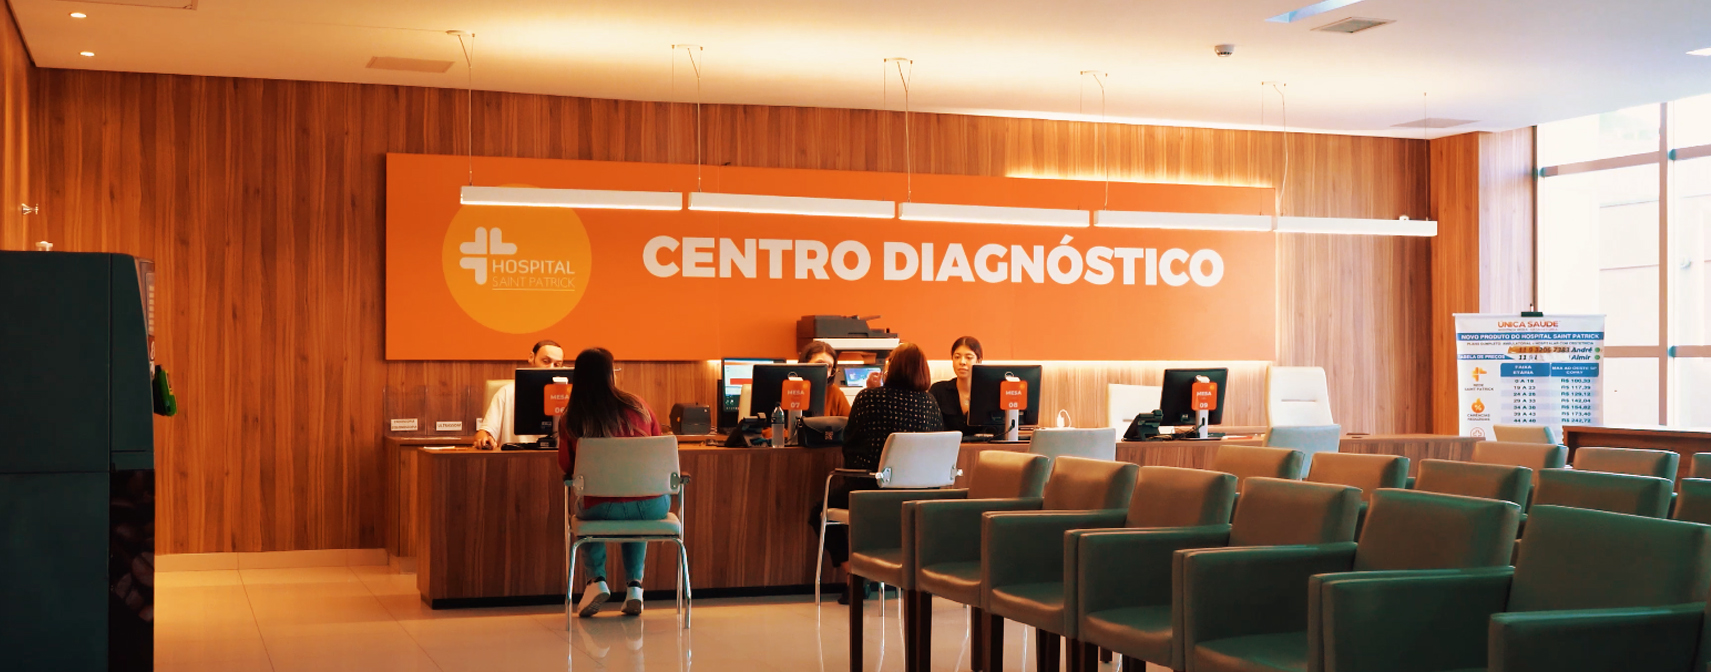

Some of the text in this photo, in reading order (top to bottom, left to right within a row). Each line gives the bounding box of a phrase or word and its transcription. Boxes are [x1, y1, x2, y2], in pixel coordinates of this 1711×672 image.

[492, 259, 575, 274] HOSPITAL
[642, 235, 1225, 287] CENTRO DIAGNÓSTICO
[492, 276, 575, 288] SAINT PATRICK
